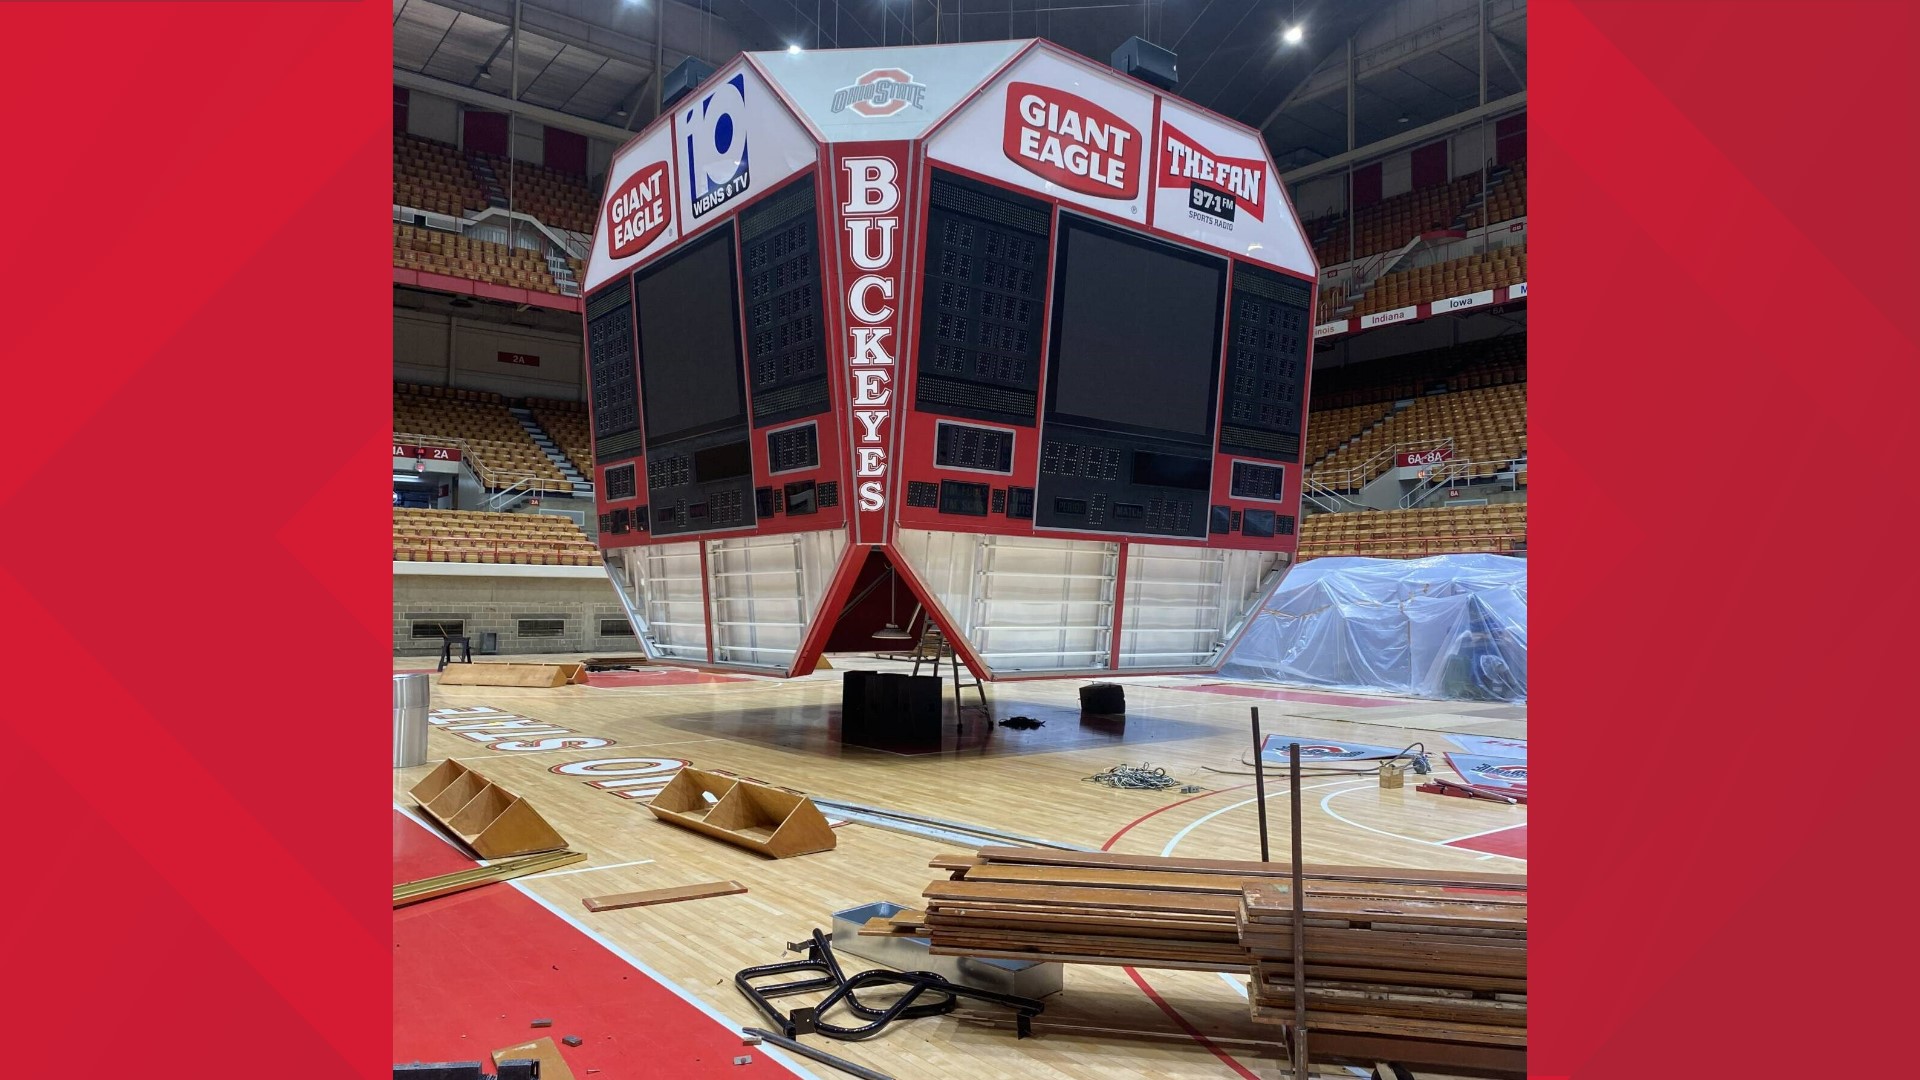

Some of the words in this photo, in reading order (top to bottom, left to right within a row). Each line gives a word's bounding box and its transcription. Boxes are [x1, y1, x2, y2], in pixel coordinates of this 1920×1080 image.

[831, 84, 875, 114] OHIO
[1019, 94, 1131, 157] GIANT
[1019, 126, 1126, 189] EAGLE
[1167, 136, 1215, 181] THE
[1215, 162, 1261, 206] FAN
[611, 169, 663, 224] GIANT
[693, 189, 725, 216] WBNS
[732, 172, 748, 193] TV
[1222, 197, 1234, 210] FM
[613, 200, 664, 250] EAGLE
[1188, 210, 1213, 225] SPORTS
[1214, 218, 1234, 232] RADIO
[1372, 312, 1405, 324] Indiana
[1450, 297, 1473, 308] Iowa
[841, 155, 901, 513] BUCKEYES
[512, 355, 525, 364] 2A
[433, 449, 449, 459] 2A
